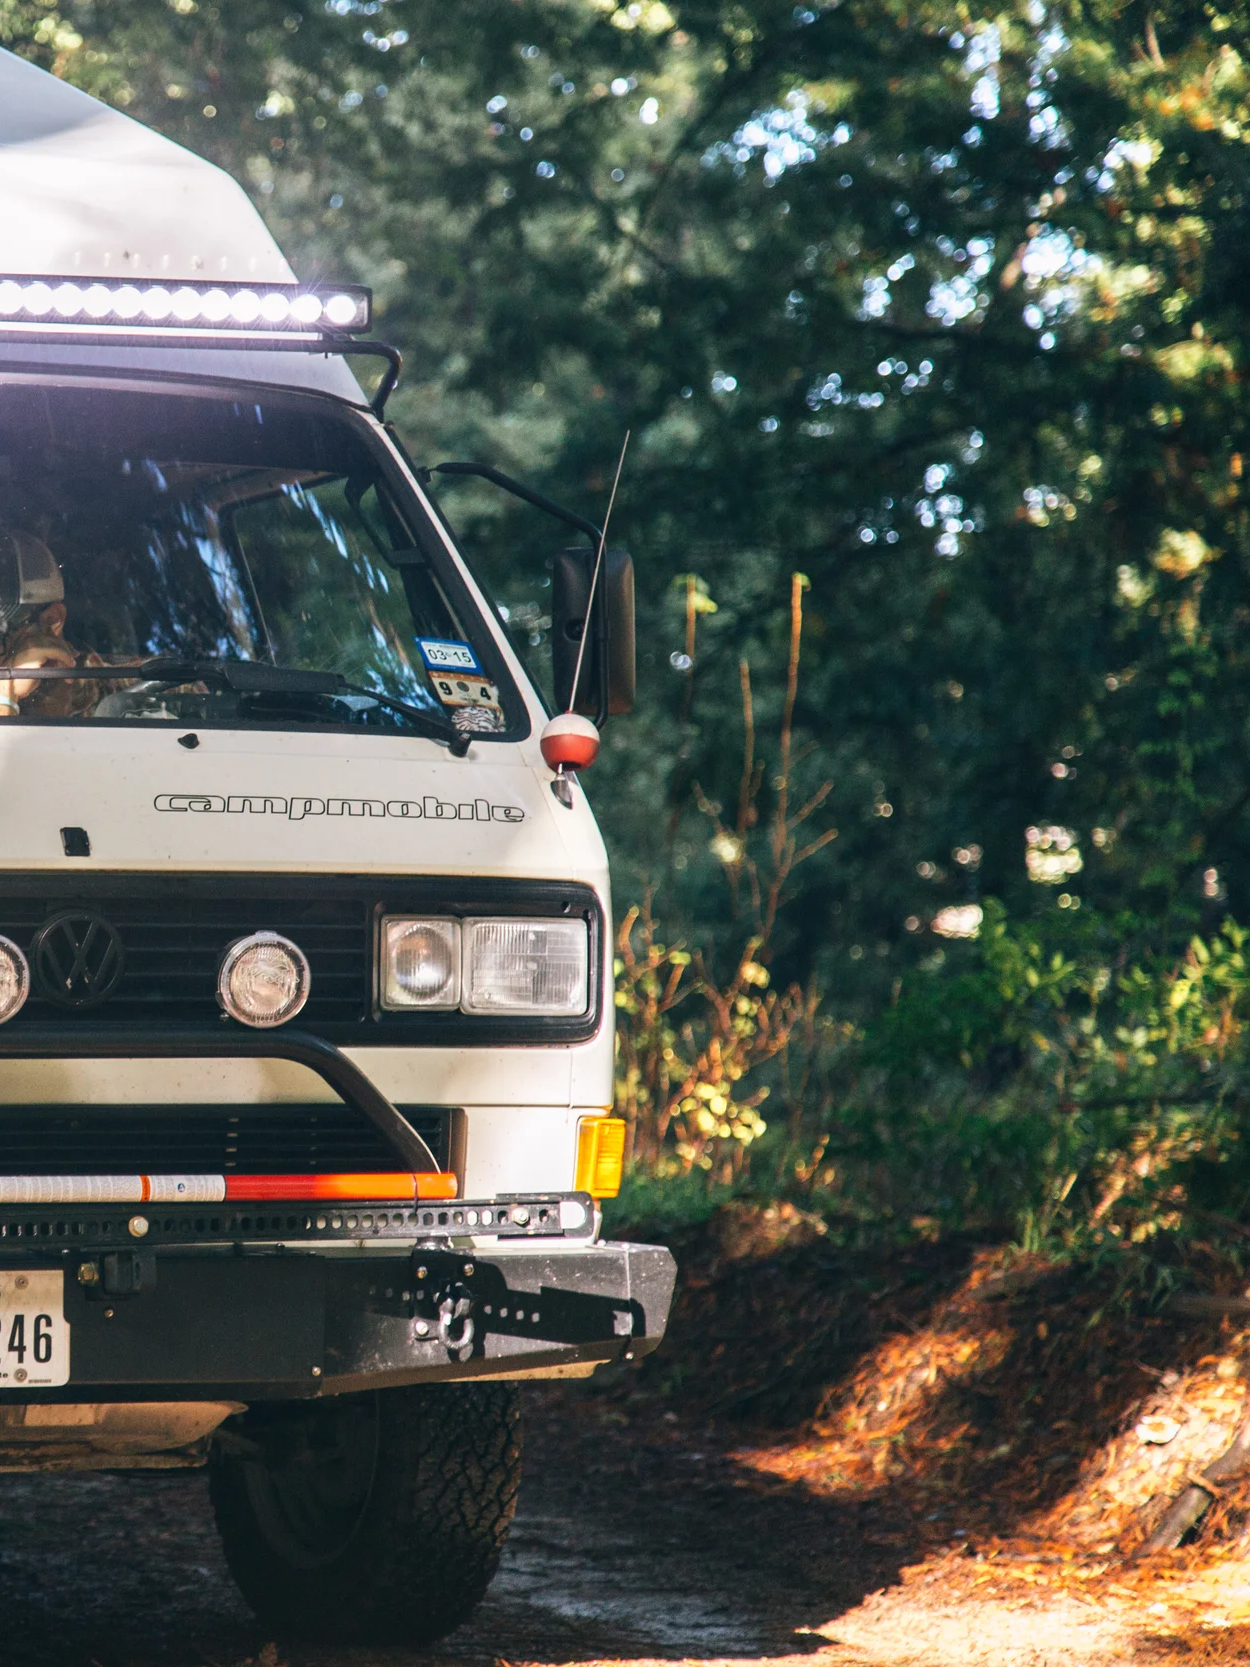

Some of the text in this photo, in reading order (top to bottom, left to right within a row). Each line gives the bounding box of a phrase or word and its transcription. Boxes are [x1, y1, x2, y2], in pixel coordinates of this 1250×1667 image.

[427, 648, 472, 663] 03 15
[438, 681, 453, 696] 9
[479, 686, 492, 700] 4
[153, 793, 525, 823] campmobile
